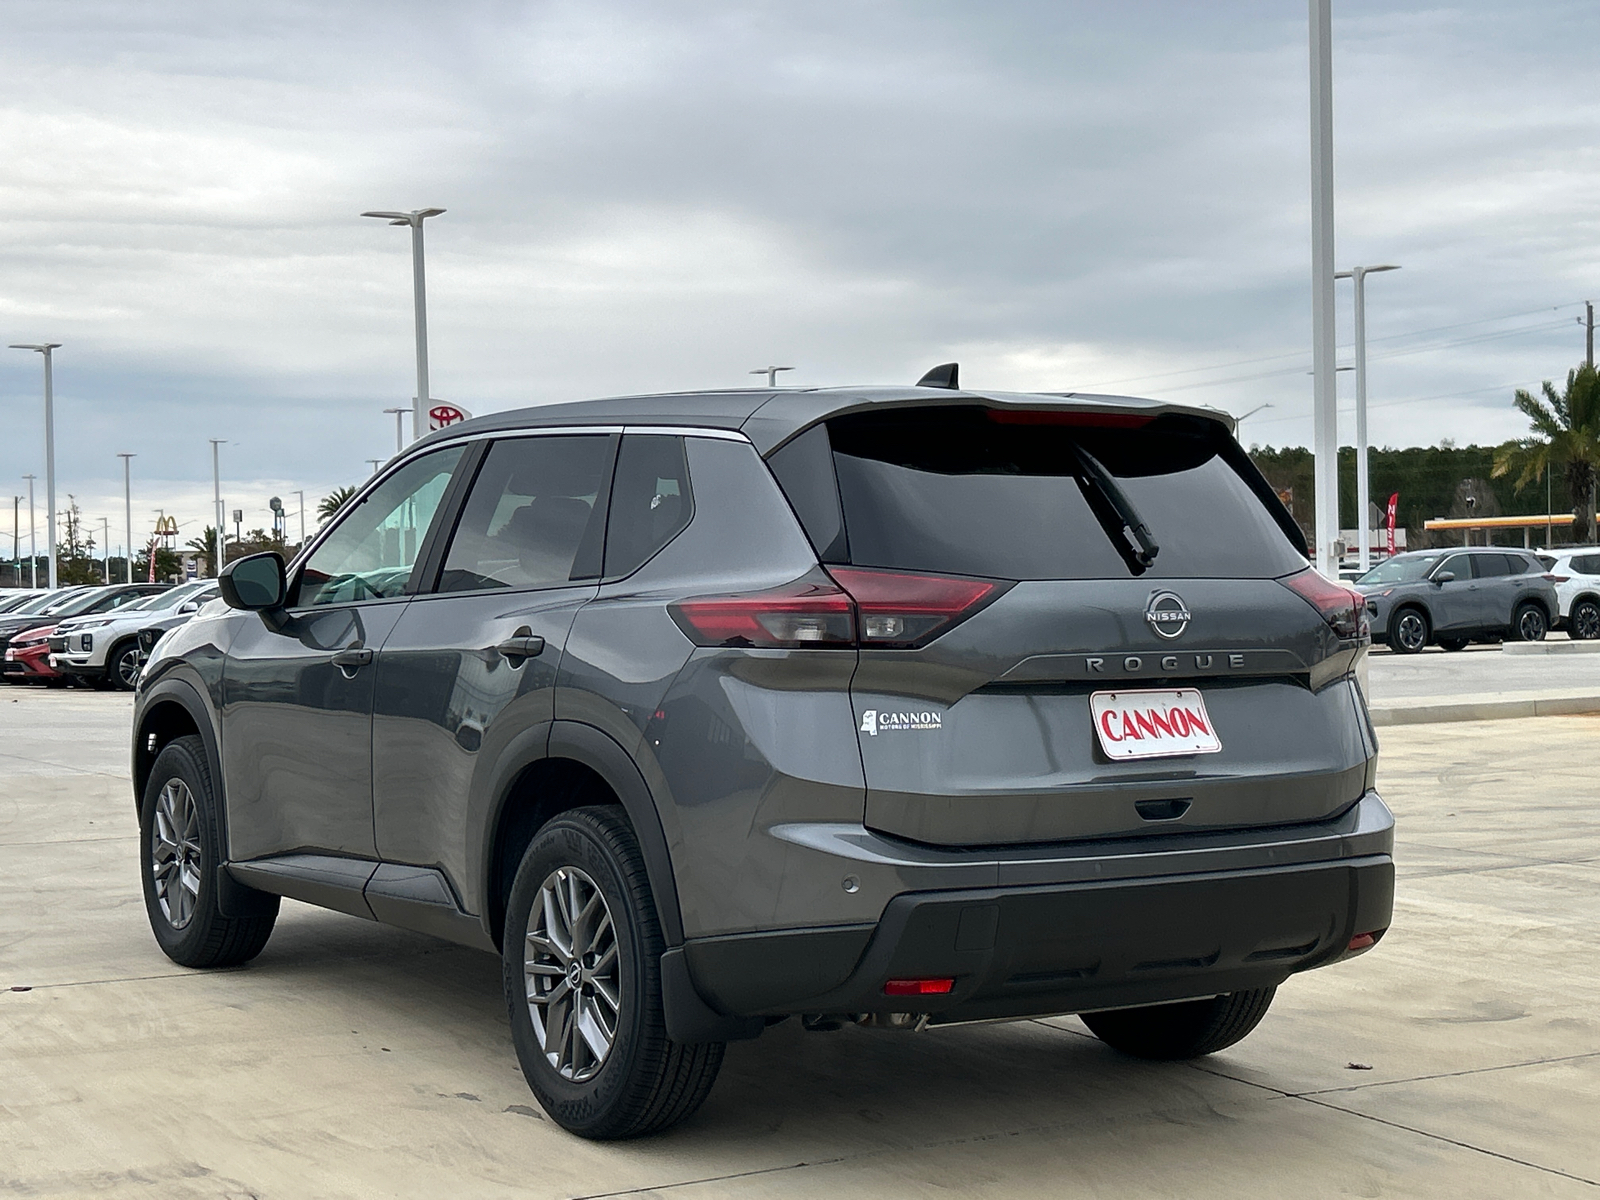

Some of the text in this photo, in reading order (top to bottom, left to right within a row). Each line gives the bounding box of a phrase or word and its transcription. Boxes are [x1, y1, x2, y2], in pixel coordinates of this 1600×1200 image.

[1147, 612, 1191, 622] NISSAN
[1085, 654, 1245, 673] ROGUE
[879, 712, 942, 724] CANNON
[1101, 707, 1210, 742] CANNON
